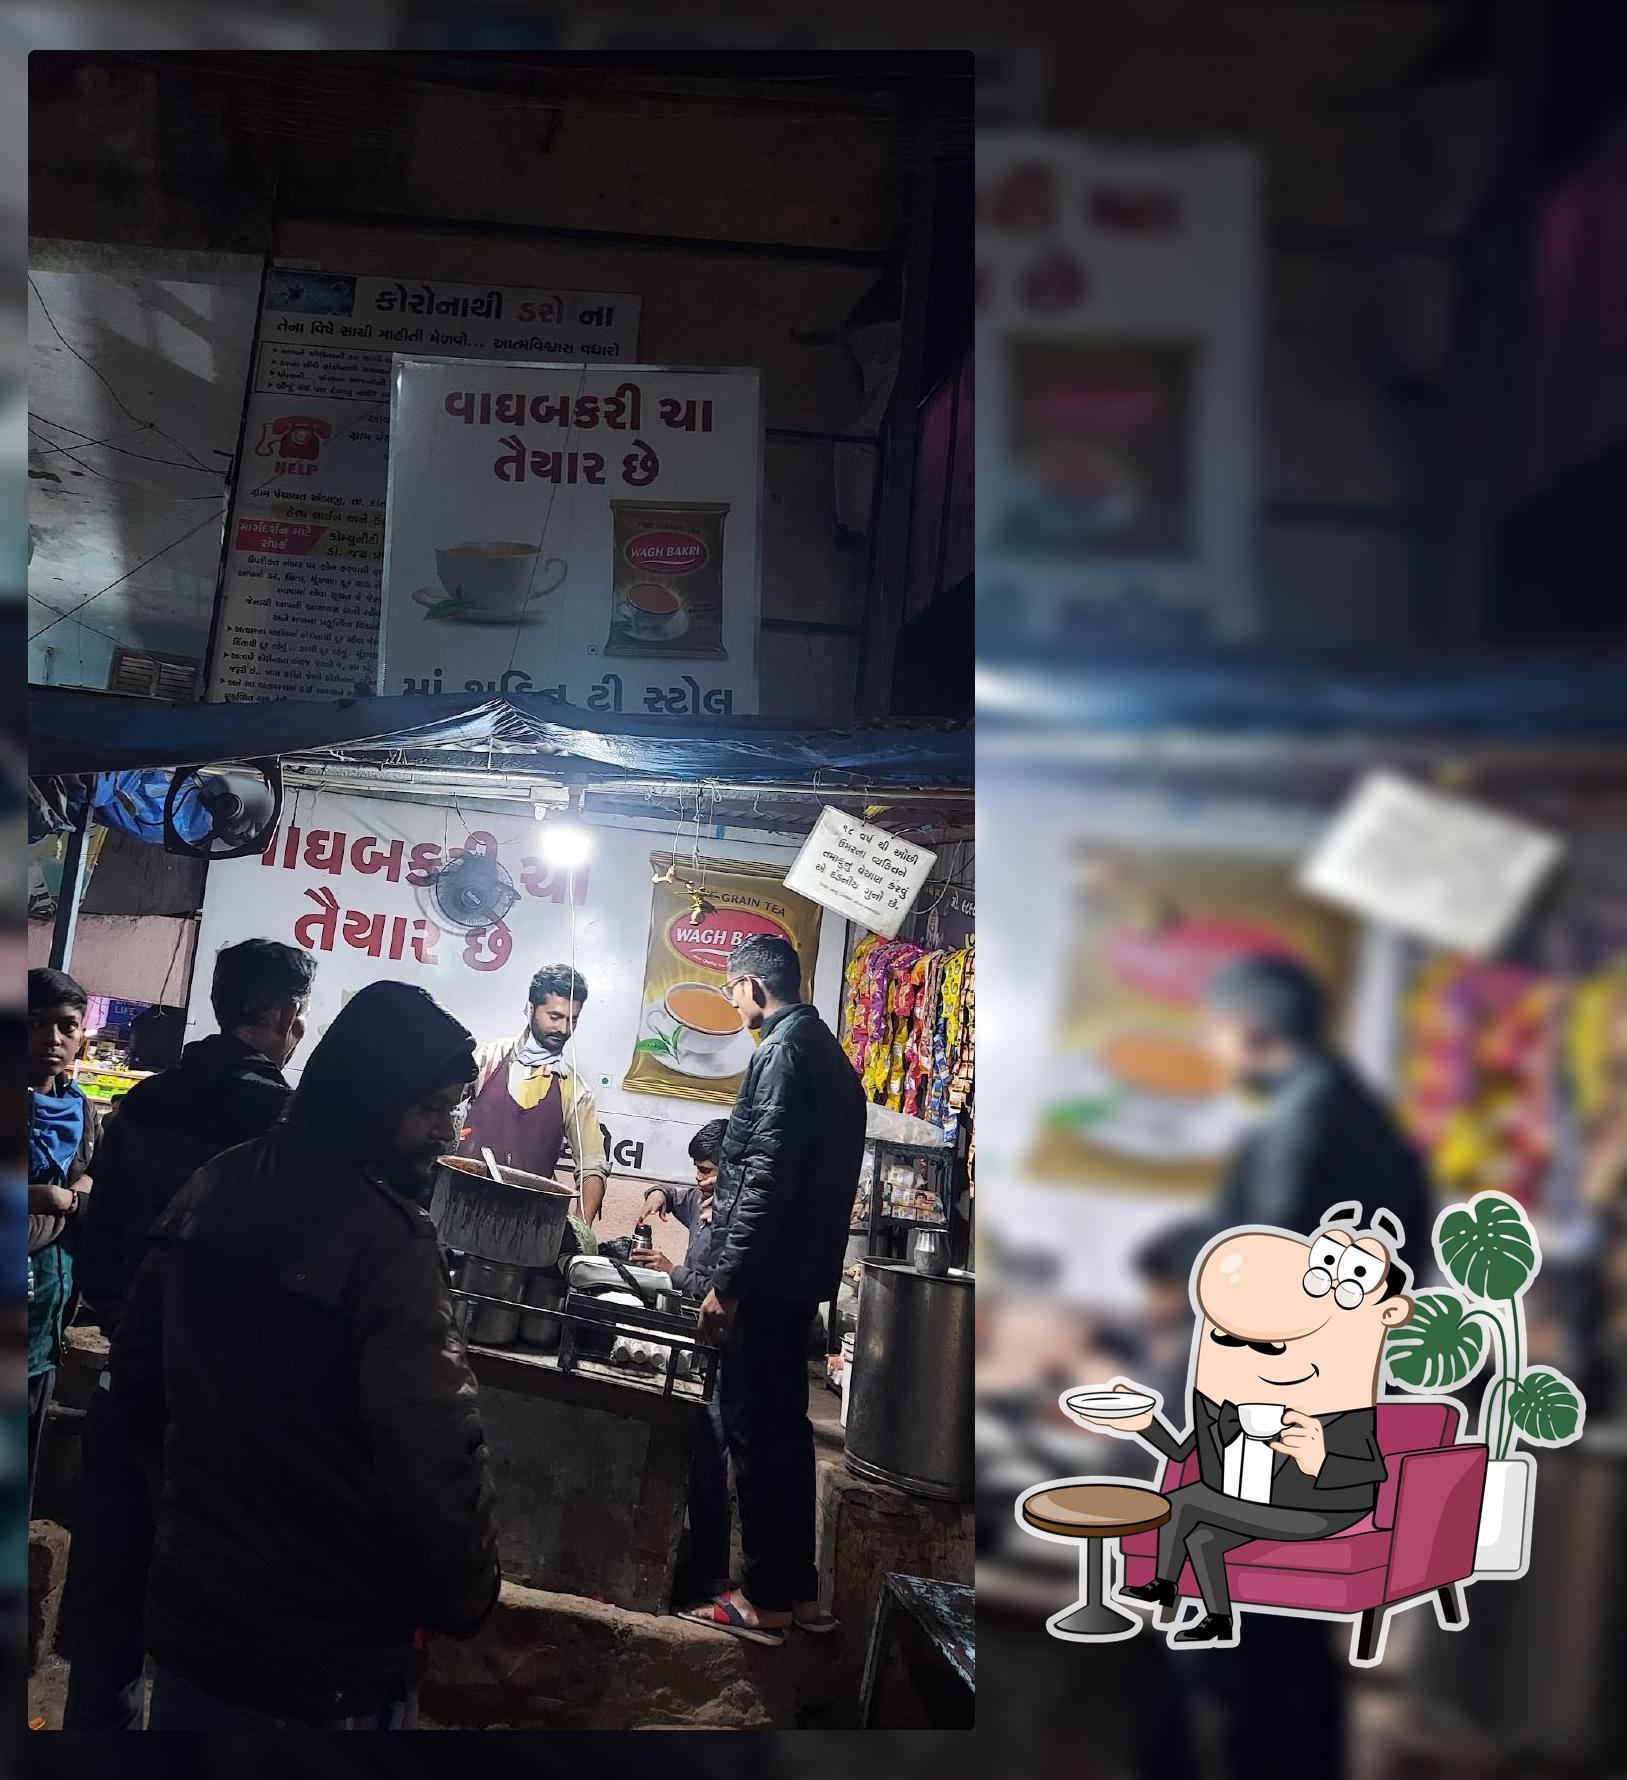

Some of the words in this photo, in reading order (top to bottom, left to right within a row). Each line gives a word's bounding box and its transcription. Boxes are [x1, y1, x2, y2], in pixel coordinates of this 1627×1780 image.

[375, 282, 503, 321] કોરોનાથી
[518, 294, 564, 324] ડરો
[579, 306, 613, 328] ના
[278, 317, 304, 334] તેના
[445, 382, 642, 431] વાઘબકરી
[659, 398, 713, 432] ચા
[274, 461, 319, 476] HELP
[494, 434, 606, 486] તૈયાર
[622, 438, 660, 487] છે
[631, 545, 664, 560] WAGH
[666, 544, 701, 559] BAKRI
[587, 673, 624, 713] ટી
[643, 675, 733, 715] સ્ટોલ
[721, 893, 760, 908] GRAIN
[765, 901, 786, 917] TEA
[293, 886, 440, 965] તૈયાર
[675, 926, 728, 946] WAGH
[115, 1005, 137, 1016] LIFE
